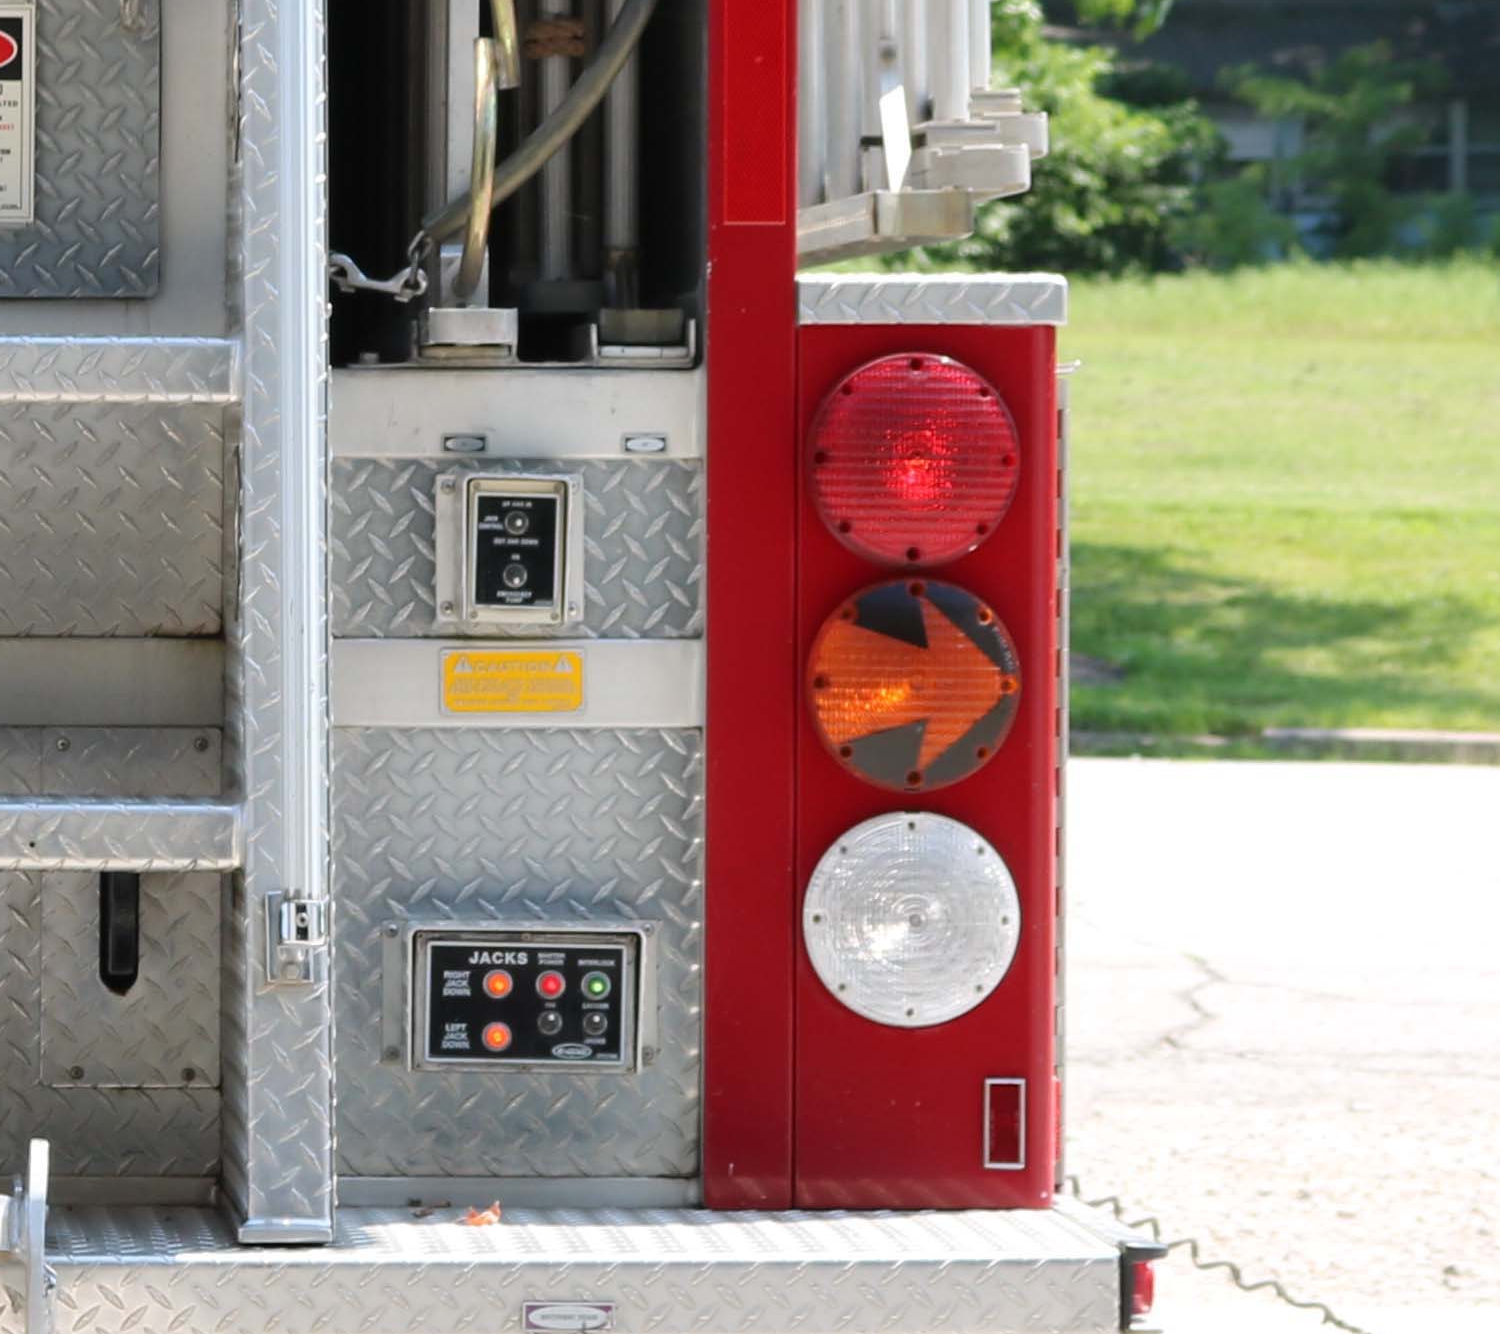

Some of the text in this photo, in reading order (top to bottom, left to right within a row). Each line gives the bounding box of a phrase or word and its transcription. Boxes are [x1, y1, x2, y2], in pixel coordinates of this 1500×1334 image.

[468, 951, 528, 965] JACKS
[443, 971, 471, 979] RIGHT
[443, 988, 471, 996] DOWN
[445, 1023, 467, 1031] LEFT
[444, 1032, 468, 1040] JACK
[442, 1040, 470, 1049] DOWN
